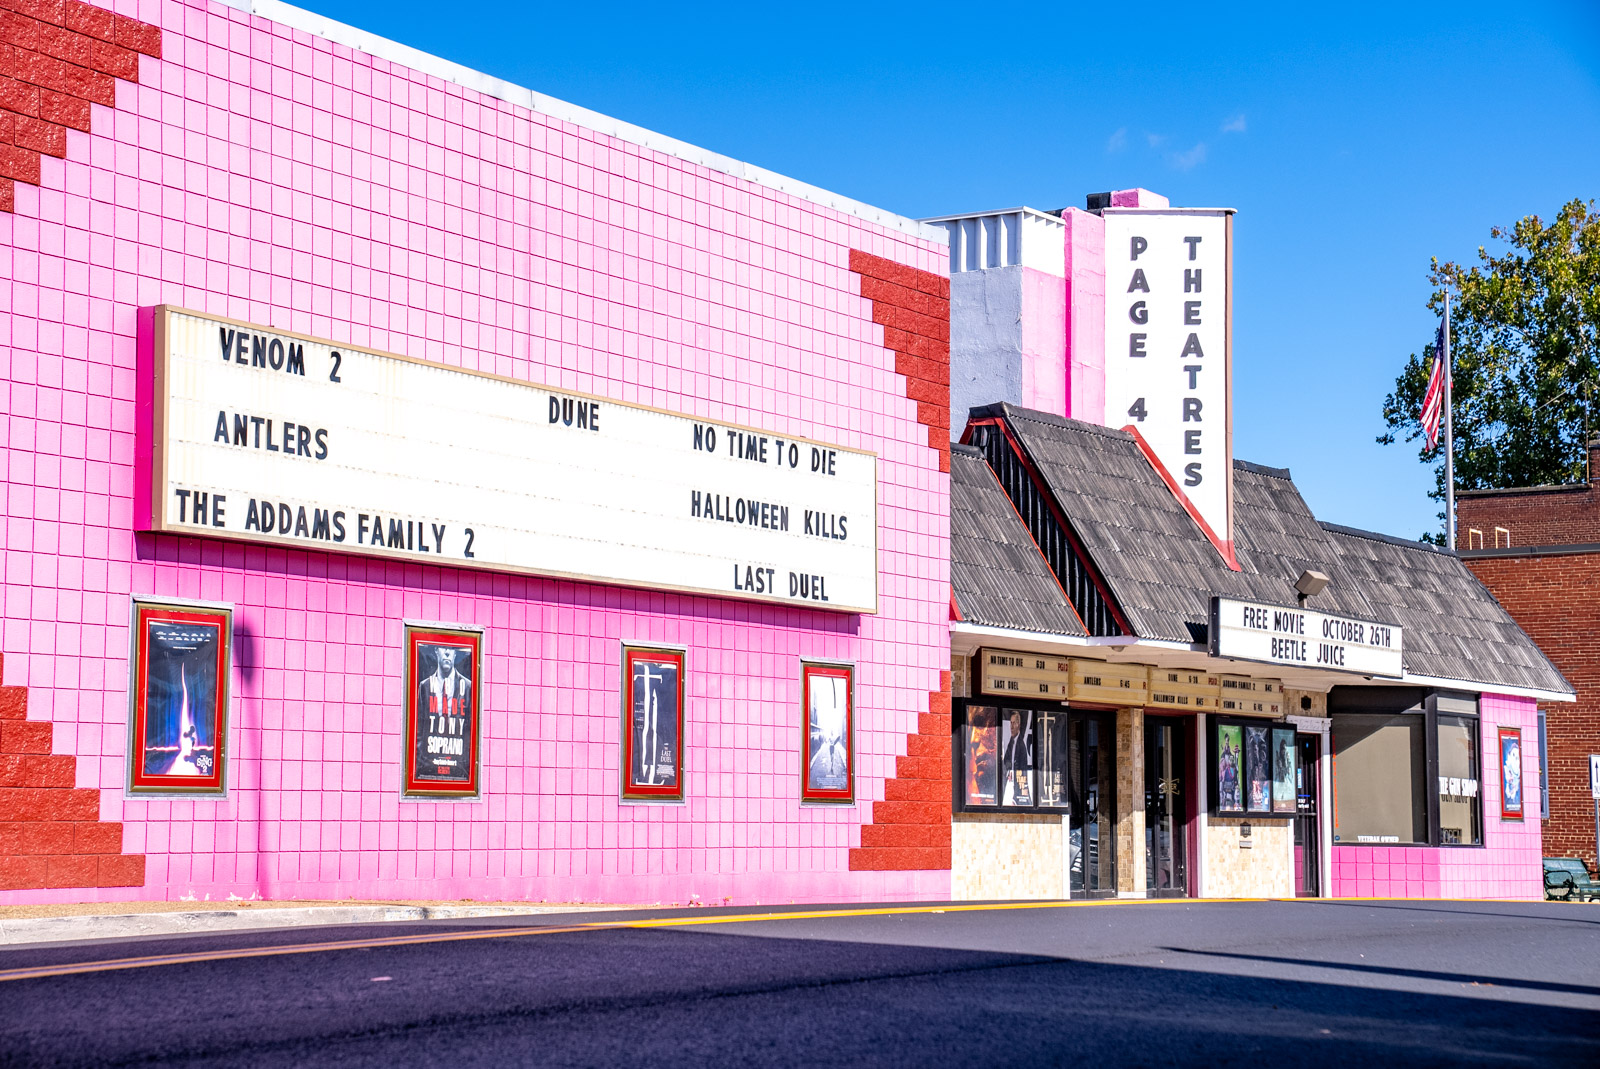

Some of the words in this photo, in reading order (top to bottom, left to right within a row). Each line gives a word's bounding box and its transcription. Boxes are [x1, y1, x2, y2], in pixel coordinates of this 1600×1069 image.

[1127, 236, 1150, 358] PAGE
[219, 327, 305, 376] VENOM
[329, 351, 342, 383] 2
[1180, 236, 1204, 487] THEATRES
[549, 395, 599, 432] DUNE
[1127, 397, 1148, 422] 4
[213, 410, 329, 460] ANTLERS
[693, 423, 716, 453] NO
[727, 430, 767, 463] TIME
[776, 440, 799, 469] TO
[811, 447, 836, 476] DIE
[175, 488, 226, 527] THE
[245, 498, 346, 542] ADDAMS
[357, 513, 446, 554] FAMILY
[464, 527, 475, 558] 2
[691, 490, 789, 532] HALLOWEEN
[804, 509, 848, 541] KILLS
[734, 564, 775, 594] LAST
[789, 571, 829, 601] DUEL
[1243, 606, 1268, 630] FREE
[1274, 611, 1305, 635] MOVIE
[1322, 618, 1364, 644] OCTOBER
[1369, 626, 1391, 648] 26TH
[990, 655, 996, 664] NO
[997, 656, 1008, 666] TIME
[1009, 657, 1014, 666] TO
[1271, 637, 1307, 662] BEETLE
[1317, 643, 1345, 666] JUICE
[994, 680, 1004, 689] LAST
[1008, 681, 1018, 690] DUEL
[1062, 686, 1065, 694] R
[1084, 676, 1101, 686] ANTLERS
[1223, 680, 1237, 688] ADDAMS
[1238, 681, 1251, 690] FAMILY
[429, 695, 466, 716] MADE
[1153, 694, 1175, 704] HALLOWEEN
[1177, 696, 1188, 705] KILLS
[429, 716, 465, 736] TONY
[427, 735, 463, 755] SOPRANO
[1449, 777, 1461, 796] GUN
